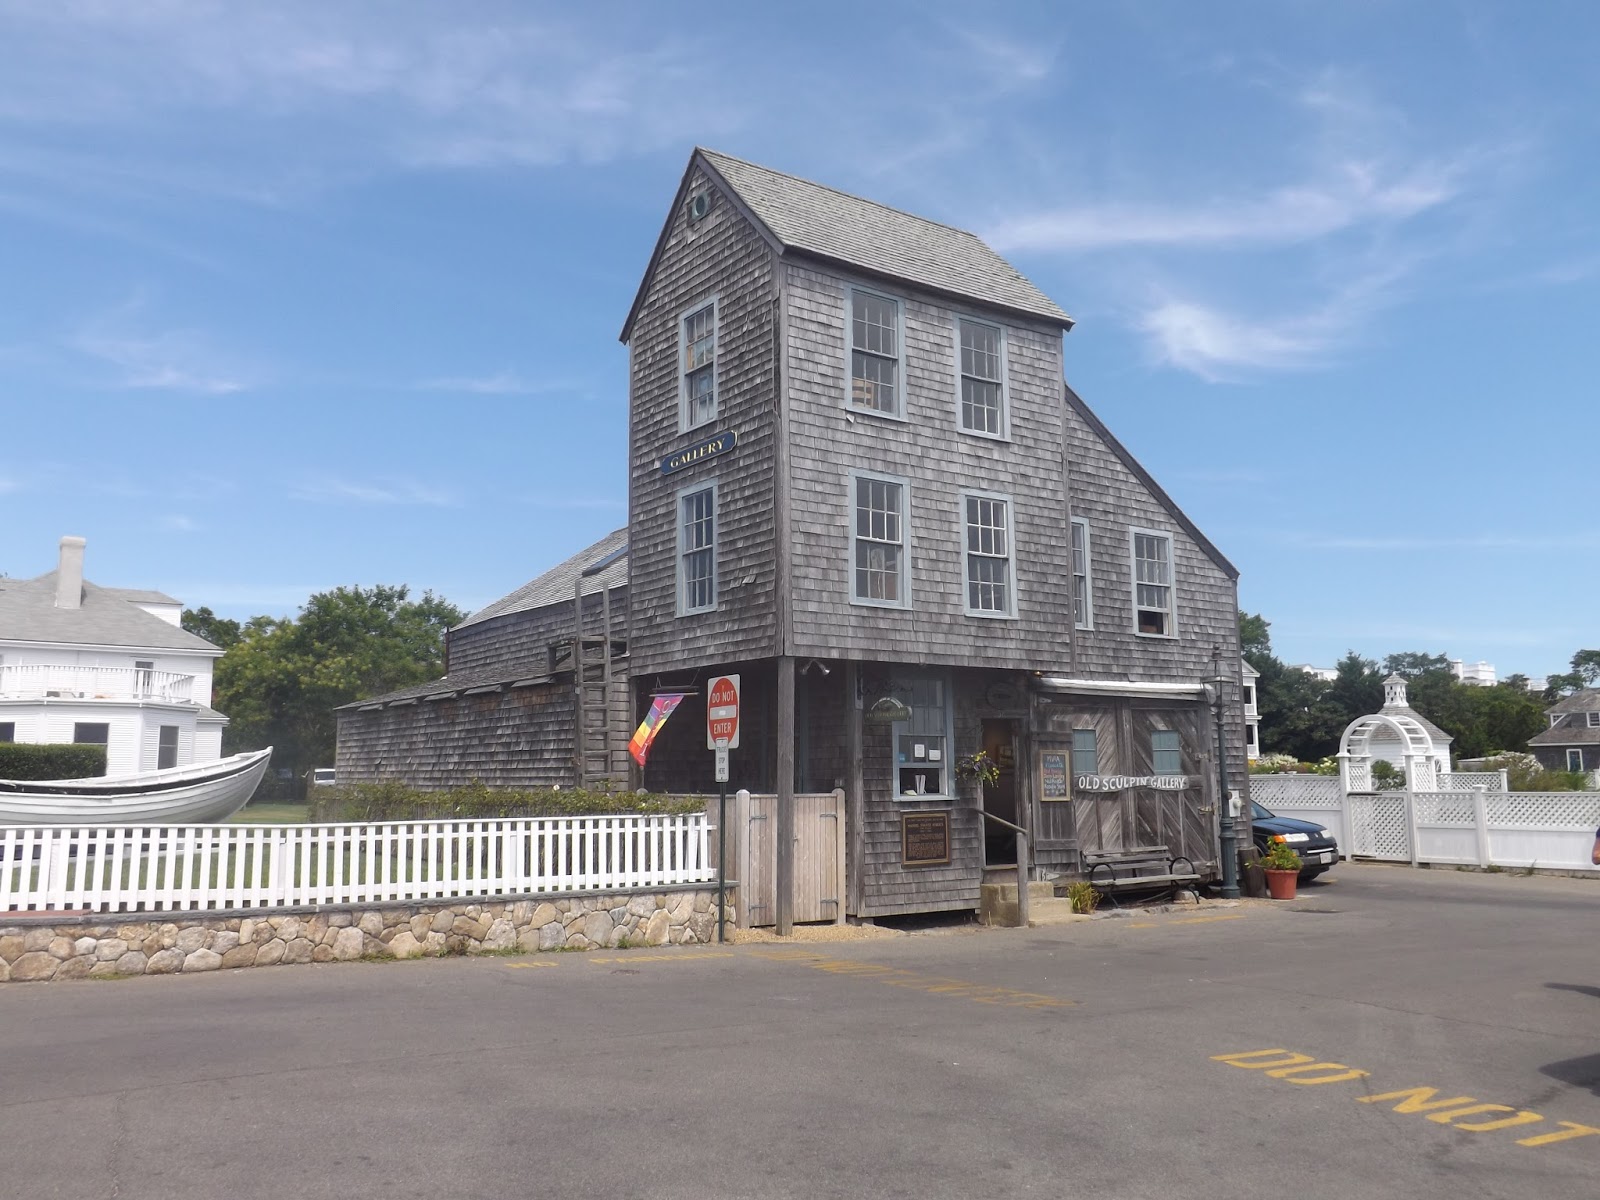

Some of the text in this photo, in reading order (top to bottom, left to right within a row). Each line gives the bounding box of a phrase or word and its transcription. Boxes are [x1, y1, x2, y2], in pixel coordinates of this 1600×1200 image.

[671, 438, 725, 468] GALLERY
[711, 690, 734, 704] DO NOT
[713, 722, 732, 735] ENTER
[1078, 776, 1185, 791] OLD SCULPIN GALLERY
[1209, 1048, 1600, 1147] DO NOT
